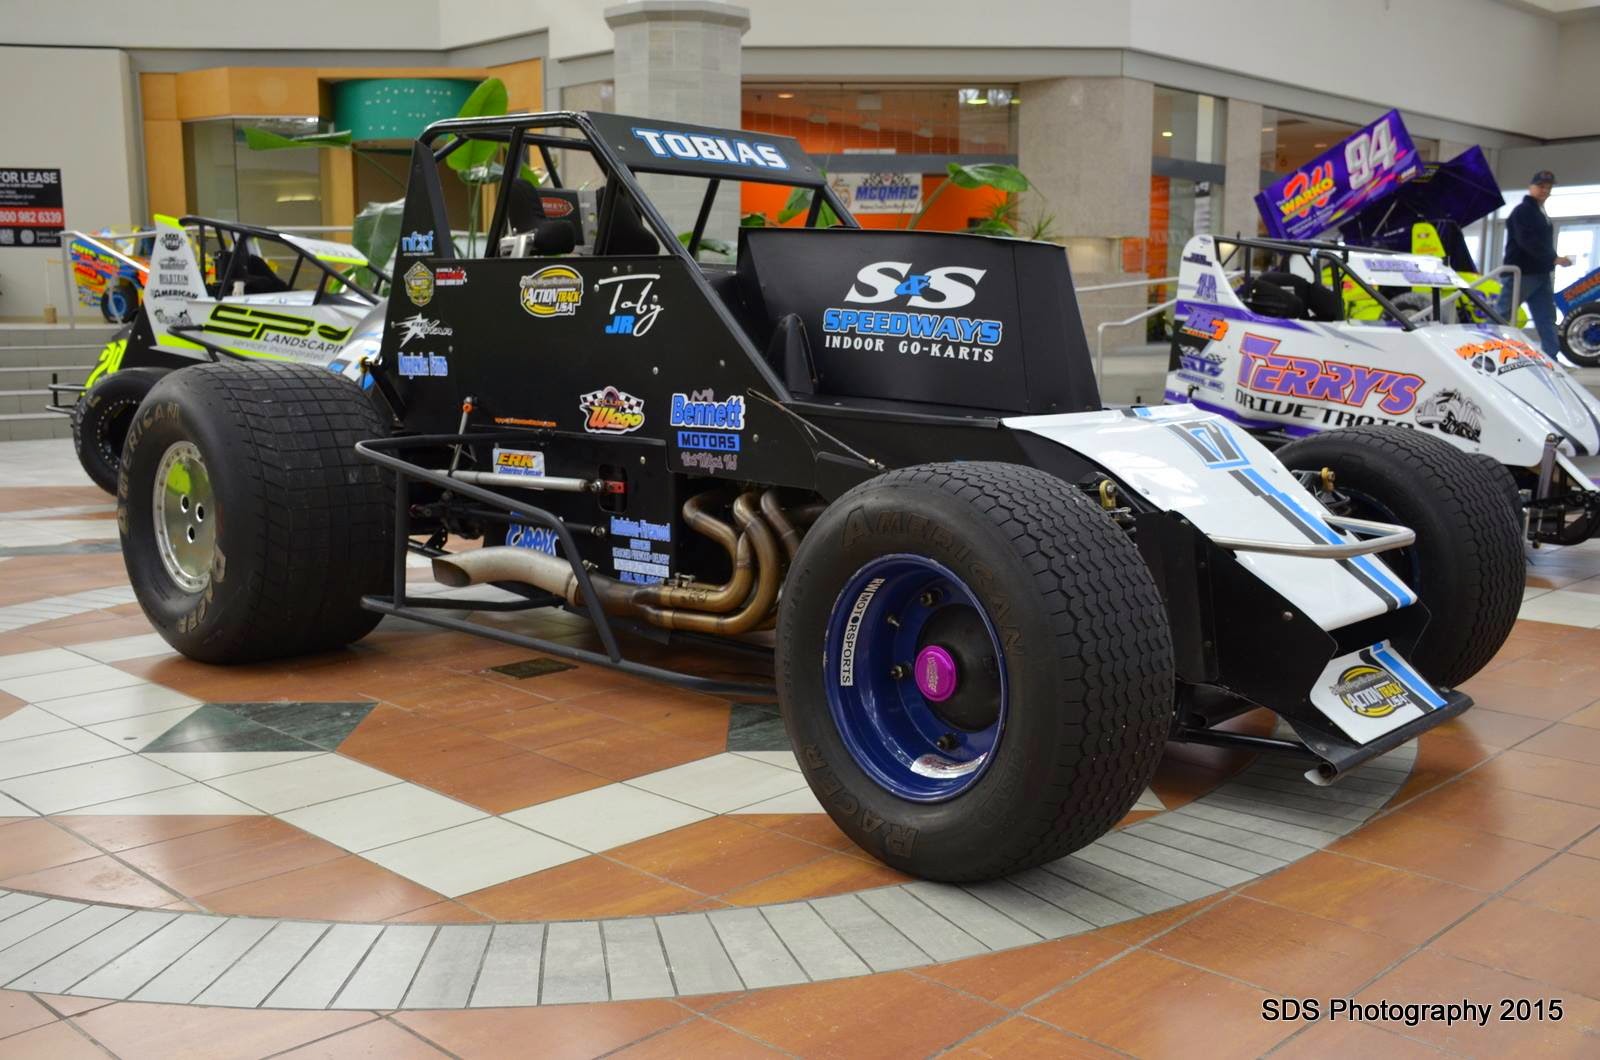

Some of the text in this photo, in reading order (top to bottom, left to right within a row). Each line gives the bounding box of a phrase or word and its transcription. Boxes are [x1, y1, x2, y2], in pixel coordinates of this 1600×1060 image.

[631, 127, 789, 170] TOBIAS
[1344, 118, 1398, 190] 94
[0, 171, 58, 184] OR LEASE
[38, 212, 61, 223] 6339
[523, 287, 581, 306] ACTION TRACK
[844, 261, 987, 310] S&S
[555, 302, 574, 313] USA
[598, 274, 664, 337] Toby
[605, 315, 635, 334] JR
[823, 307, 1003, 346] SPEEDWAYS
[825, 335, 994, 363] INDOOR GO-KARTS
[1237, 332, 1426, 416] TERRY'S
[670, 393, 746, 430] Bennett
[1234, 388, 1414, 430] DRIVETRA
[681, 433, 736, 449] MOTORS
[1346, 687, 1382, 711] ACTION
[1377, 682, 1404, 698] TRACK
[801, 742, 919, 858] RACER
